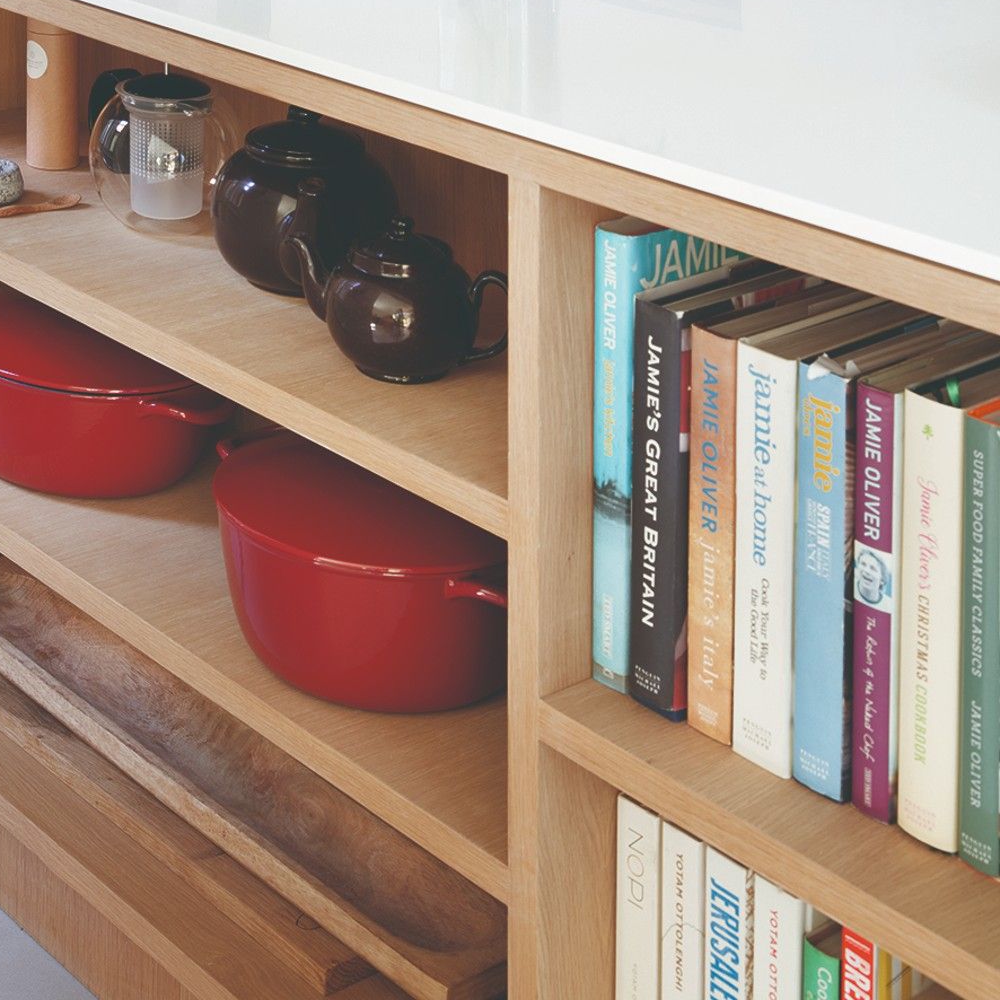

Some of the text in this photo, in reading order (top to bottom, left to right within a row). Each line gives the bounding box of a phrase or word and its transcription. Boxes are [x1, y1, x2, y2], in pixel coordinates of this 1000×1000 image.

[604, 239, 616, 350] JAMIE OLIVER
[641, 335, 662, 627] JAMIE'S GREAT BRITAIN
[702, 358, 719, 533] JAMIE OLIVER
[748, 363, 777, 566] jamie at home
[808, 393, 840, 493] jamie
[863, 398, 882, 541] JAMIE OLIVER
[817, 502, 831, 548] SPAIN
[917, 475, 939, 527] Jamie
[700, 536, 720, 627] jamie's
[750, 589, 759, 664] the Good Life
[866, 616, 876, 631] The
[970, 450, 984, 808] SUPER FOOD FAMILY CLASSICS JAMIE OLIVER
[698, 636, 719, 689] italy
[759, 578, 770, 681] Cook Your Way to
[916, 594, 930, 682] CHRISTMAS
[914, 684, 928, 765] COOKBOOK
[626, 828, 644, 911] NOPI
[675, 853, 684, 992] YOTAM OTTOLENGHI
[710, 878, 741, 1000] JERUSALE
[769, 910, 778, 959] YOTAM
